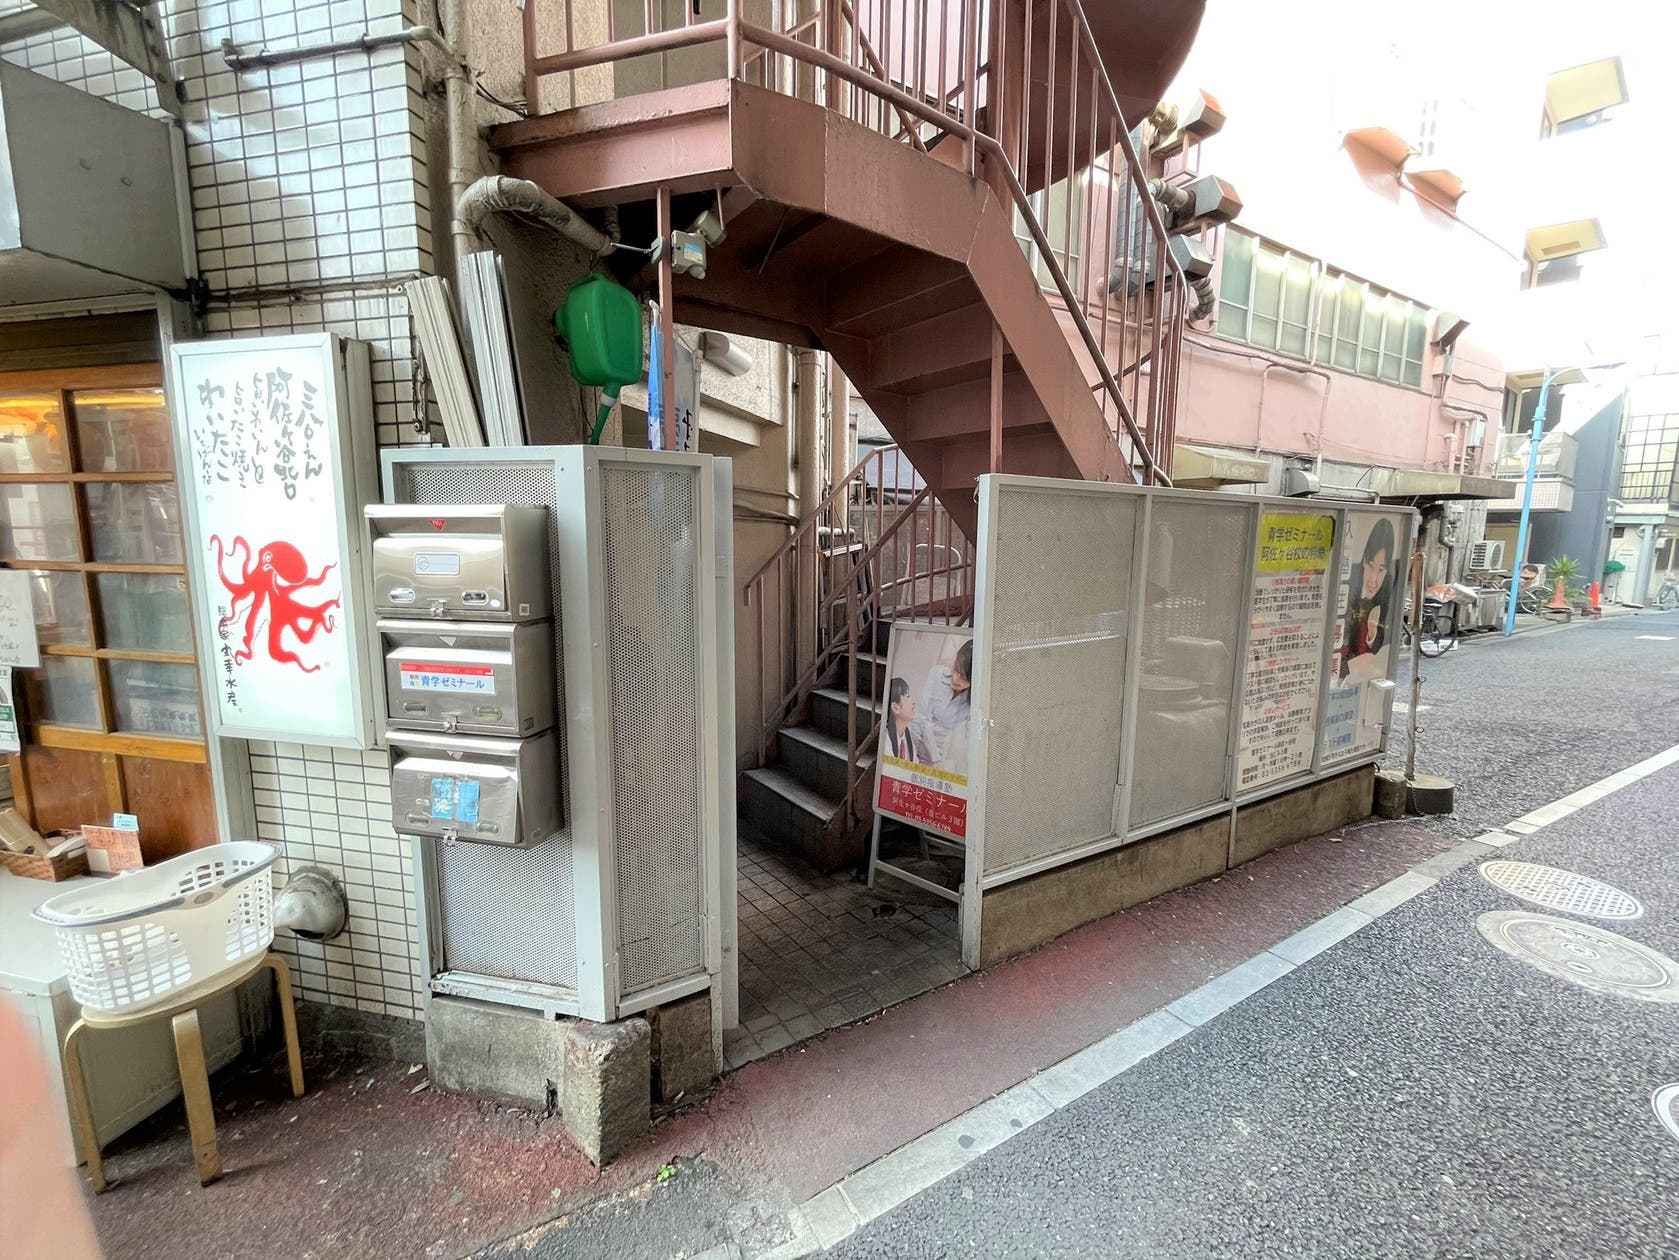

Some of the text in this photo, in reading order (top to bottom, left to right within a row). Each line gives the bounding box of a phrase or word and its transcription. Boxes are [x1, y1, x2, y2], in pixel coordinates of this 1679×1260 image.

[1268, 526, 1324, 542] 青学ゼミナール
[421, 675, 485, 689] 青学ゼミナール
